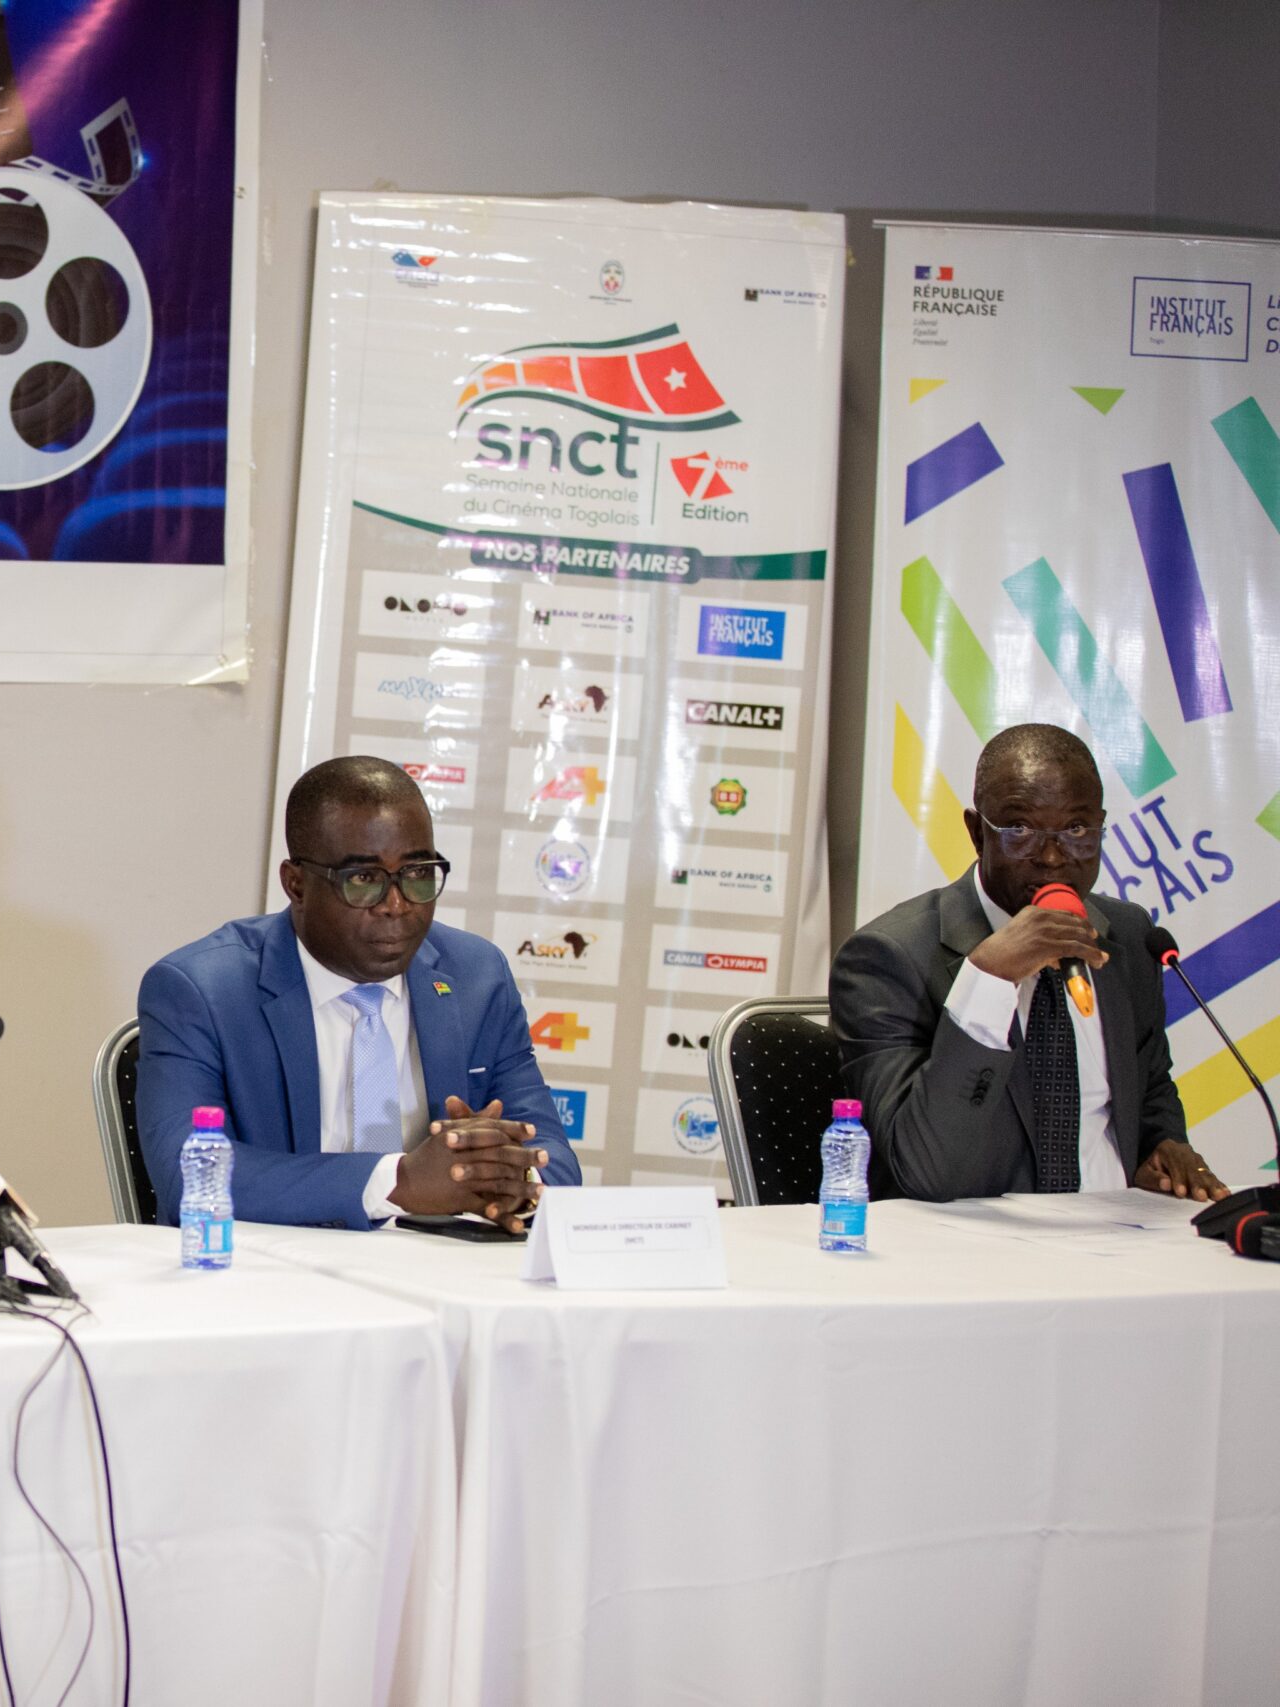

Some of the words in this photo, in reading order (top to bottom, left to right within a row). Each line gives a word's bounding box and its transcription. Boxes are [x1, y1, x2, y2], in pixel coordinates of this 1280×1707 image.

[913, 284, 1005, 303] RÉPUBLIQUE
[912, 301, 997, 317] FRANÇAISE
[1150, 296, 1226, 318] INSTITUT
[1149, 313, 1233, 338] FRANÇAIS
[474, 422, 639, 479] snct
[466, 474, 546, 495] Semaine
[551, 481, 638, 503] Nationale
[463, 498, 487, 513] du
[493, 499, 562, 520] Cinéma
[567, 505, 639, 528] Togolais
[682, 502, 749, 523] Edition
[484, 541, 538, 563] NOS
[542, 546, 691, 576] PARTENAIRES
[582, 611, 595, 620] OF
[710, 613, 769, 633] INSTITUT
[687, 702, 781, 727] CANAL+
[720, 871, 732, 879] OF
[736, 872, 773, 882] AFRICA
